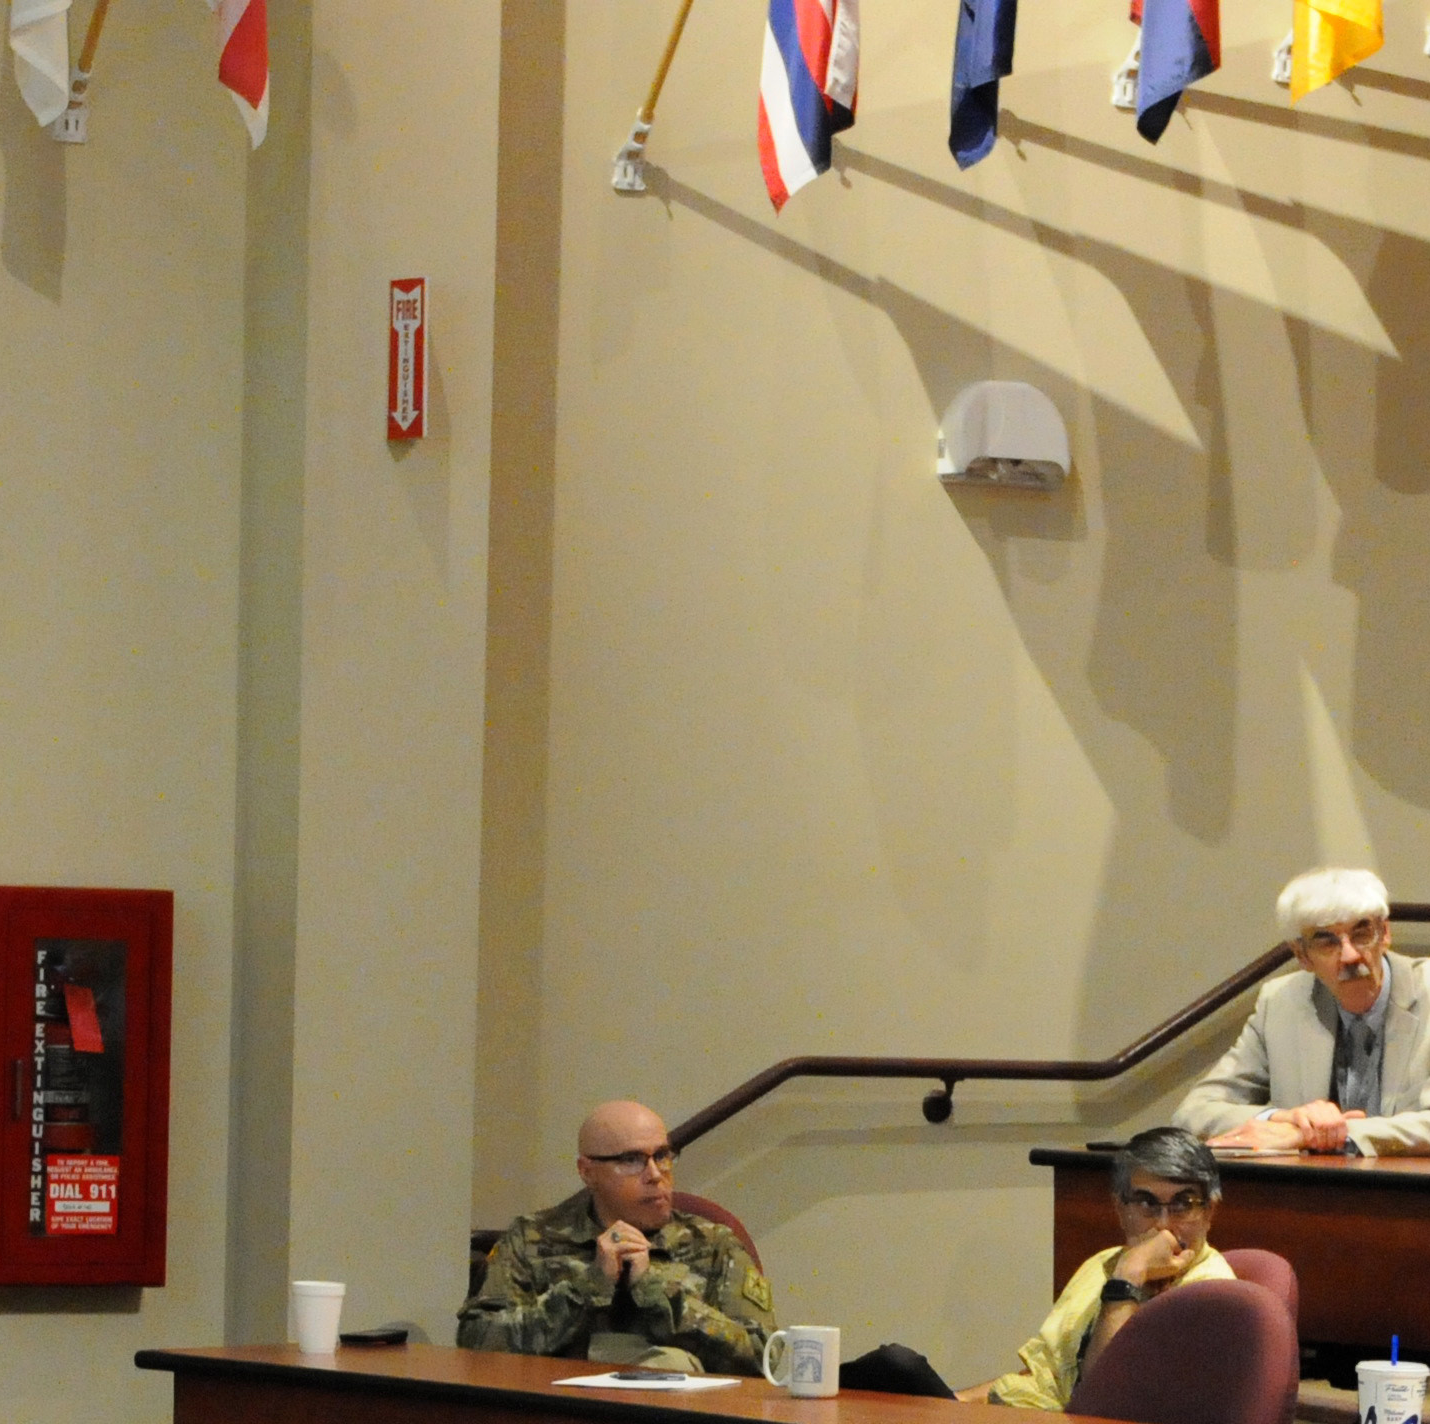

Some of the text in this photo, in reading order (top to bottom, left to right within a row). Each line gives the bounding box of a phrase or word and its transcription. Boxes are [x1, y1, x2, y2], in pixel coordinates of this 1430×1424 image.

[396, 299, 418, 320] FIRE
[401, 324, 410, 421] EXTINGUISHER
[29, 950, 48, 1222] FIRE EXTINGUISHER
[49, 1183, 116, 1200] DIAL 911
